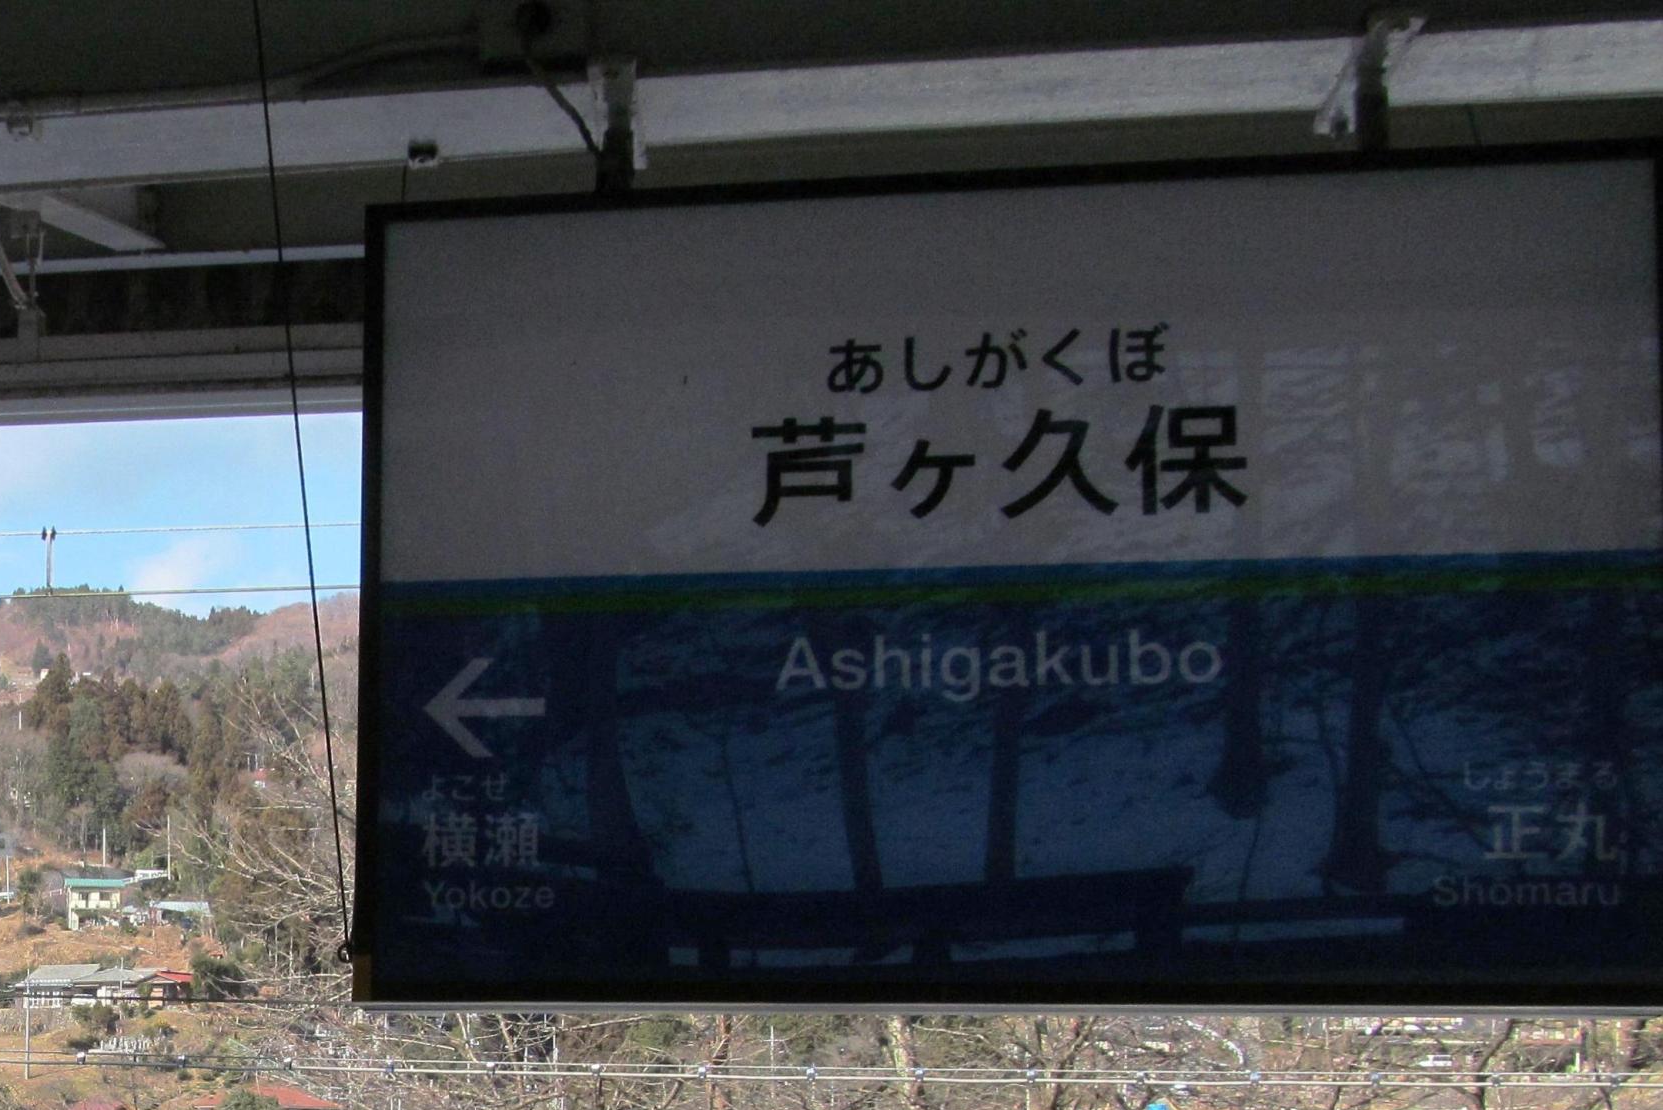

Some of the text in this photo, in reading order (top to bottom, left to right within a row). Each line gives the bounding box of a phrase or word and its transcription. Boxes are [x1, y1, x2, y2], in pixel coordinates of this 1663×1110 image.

[827, 322, 1169, 393] あしがくぼ
[752, 405, 1248, 526] 芦ヶ久保
[777, 631, 1222, 702] Ashigakubo
[422, 812, 539, 867] 横瀬
[1485, 799, 1617, 861] 正丸
[424, 880, 555, 909] Yokoze
